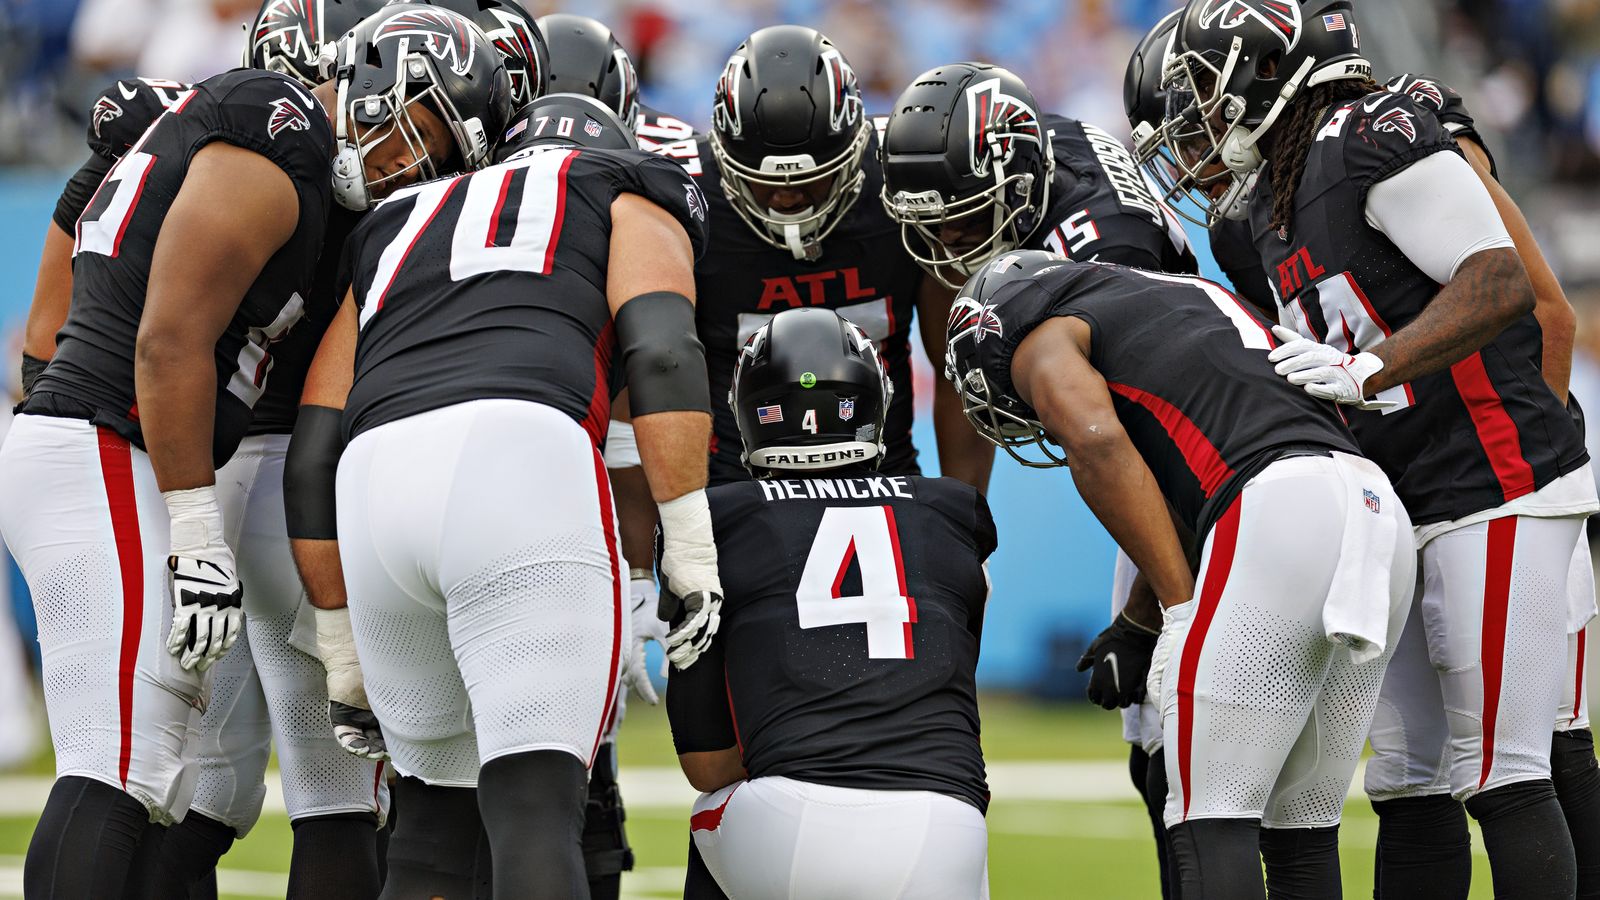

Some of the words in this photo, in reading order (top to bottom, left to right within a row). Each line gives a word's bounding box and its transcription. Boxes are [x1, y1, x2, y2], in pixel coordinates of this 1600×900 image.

[534, 116, 575, 137] 70
[475, 130, 488, 153] ATL
[775, 162, 803, 171] ATL
[905, 196, 927, 205] ATL
[359, 149, 581, 333] 70
[1042, 208, 1101, 258] 15
[1276, 246, 1326, 299] ATL
[756, 267, 876, 310] ATL
[802, 409, 819, 435] 4
[765, 448, 866, 465] FALCONS
[758, 475, 914, 502] HEINICKE
[795, 505, 919, 660] 4
